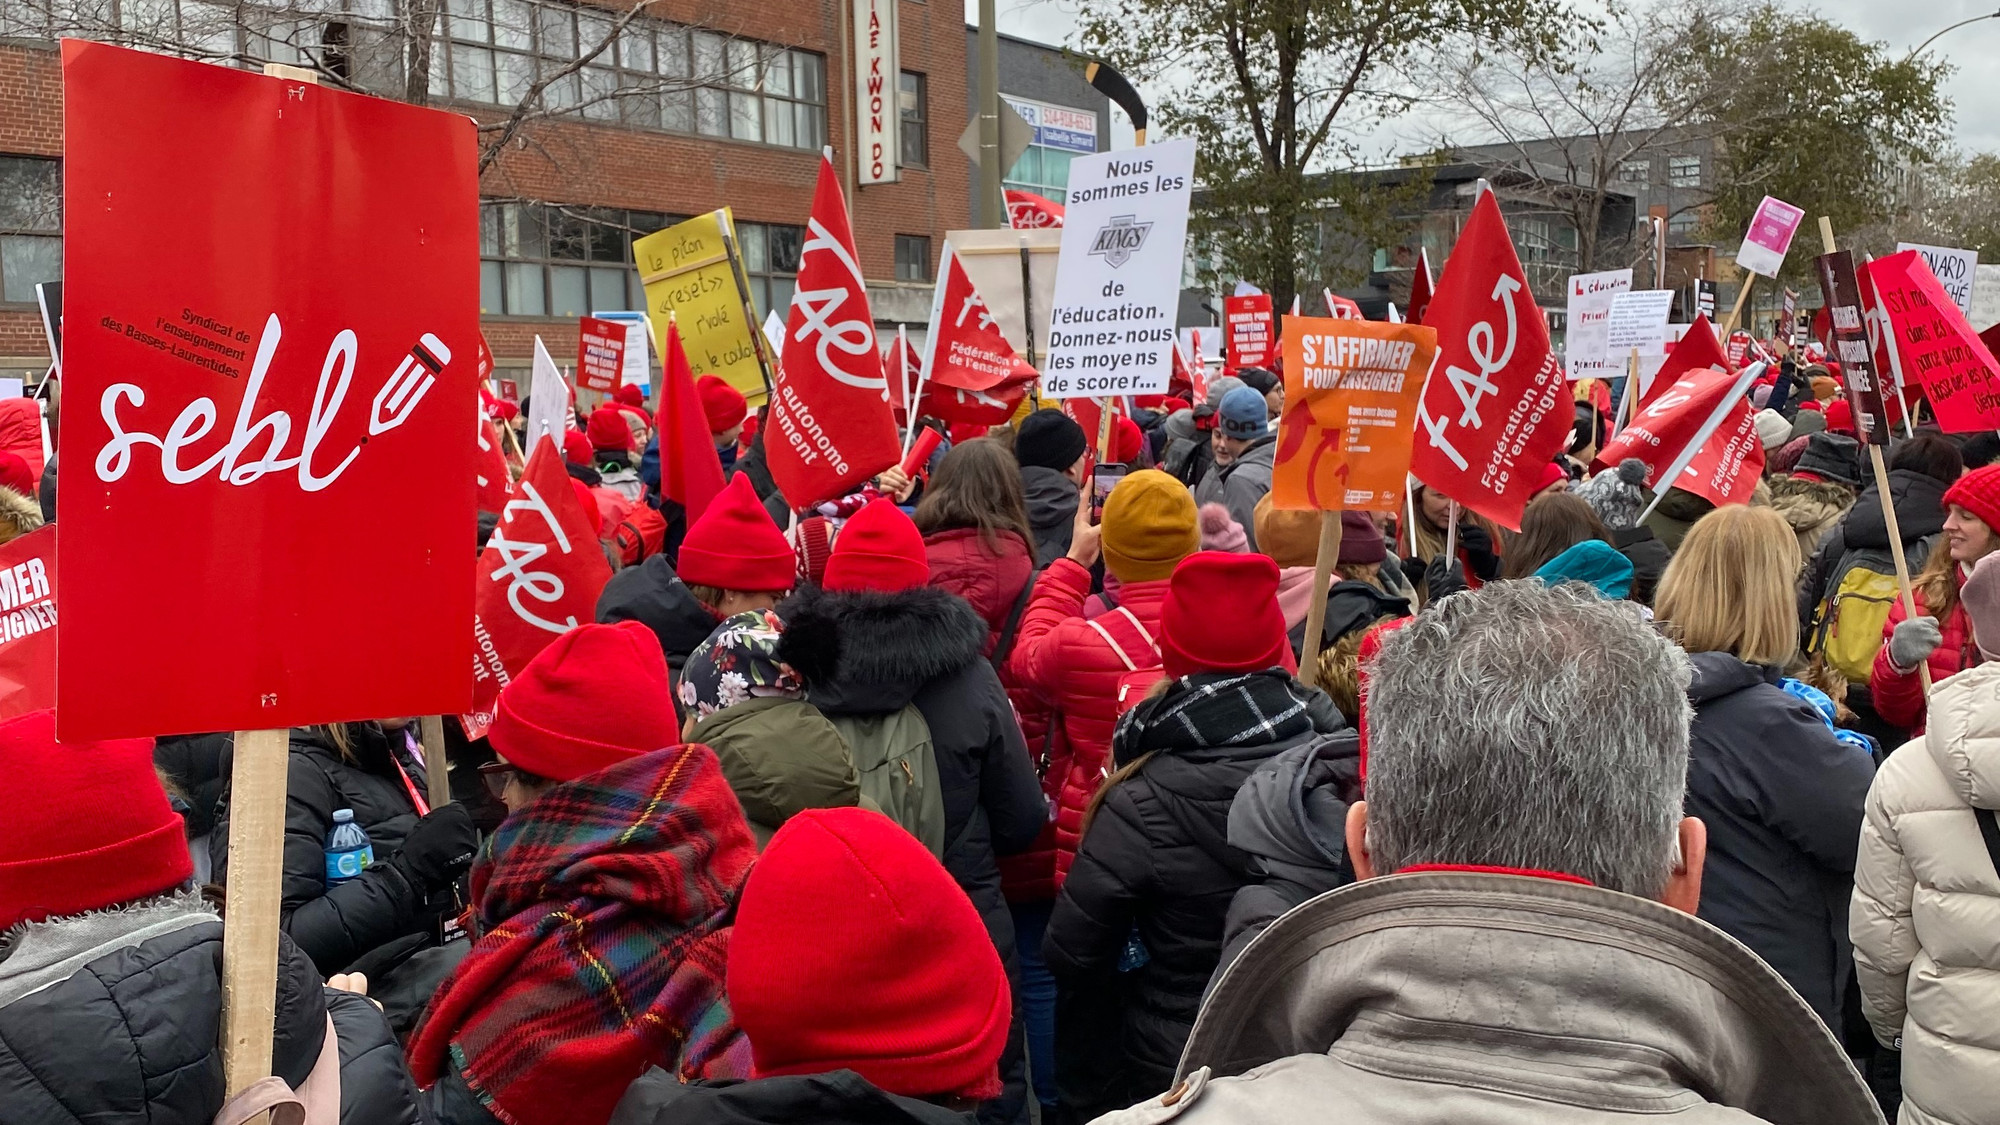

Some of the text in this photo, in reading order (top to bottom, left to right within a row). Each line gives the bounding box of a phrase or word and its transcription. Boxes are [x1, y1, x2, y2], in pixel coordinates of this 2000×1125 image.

[867, 57, 883, 134] KWON
[871, 143, 883, 179] DO
[1106, 159, 1154, 178] Nous
[1071, 175, 1184, 204] sommes les
[1093, 226, 1146, 251] KINGS
[648, 236, 705, 272] Le piton
[1102, 280, 1125, 297] de
[181, 307, 251, 345] Syndicat de
[1052, 302, 1165, 325] l'éducation.
[1581, 307, 1609, 324] priorit
[101, 315, 240, 379] des Basses-Laurentides
[155, 316, 247, 362] l'enseignement
[1050, 327, 1173, 348] Donnez-nous
[704, 348, 720, 369] le
[723, 339, 757, 366] couloi
[948, 353, 963, 366] de
[950, 340, 1010, 367] Fédération
[1049, 350, 1158, 372] les moyens
[1302, 334, 1417, 371] S'AFFIRMER
[1047, 374, 1158, 392] de scorer...
[1303, 366, 1406, 394] POUR ENSEIGNER
[95, 312, 361, 492] sebl
[782, 385, 849, 476] autonome
[1481, 387, 1538, 488] Fédération
[1494, 470, 1509, 495] de
[1721, 481, 1732, 497] de
[474, 614, 512, 688] autonom
